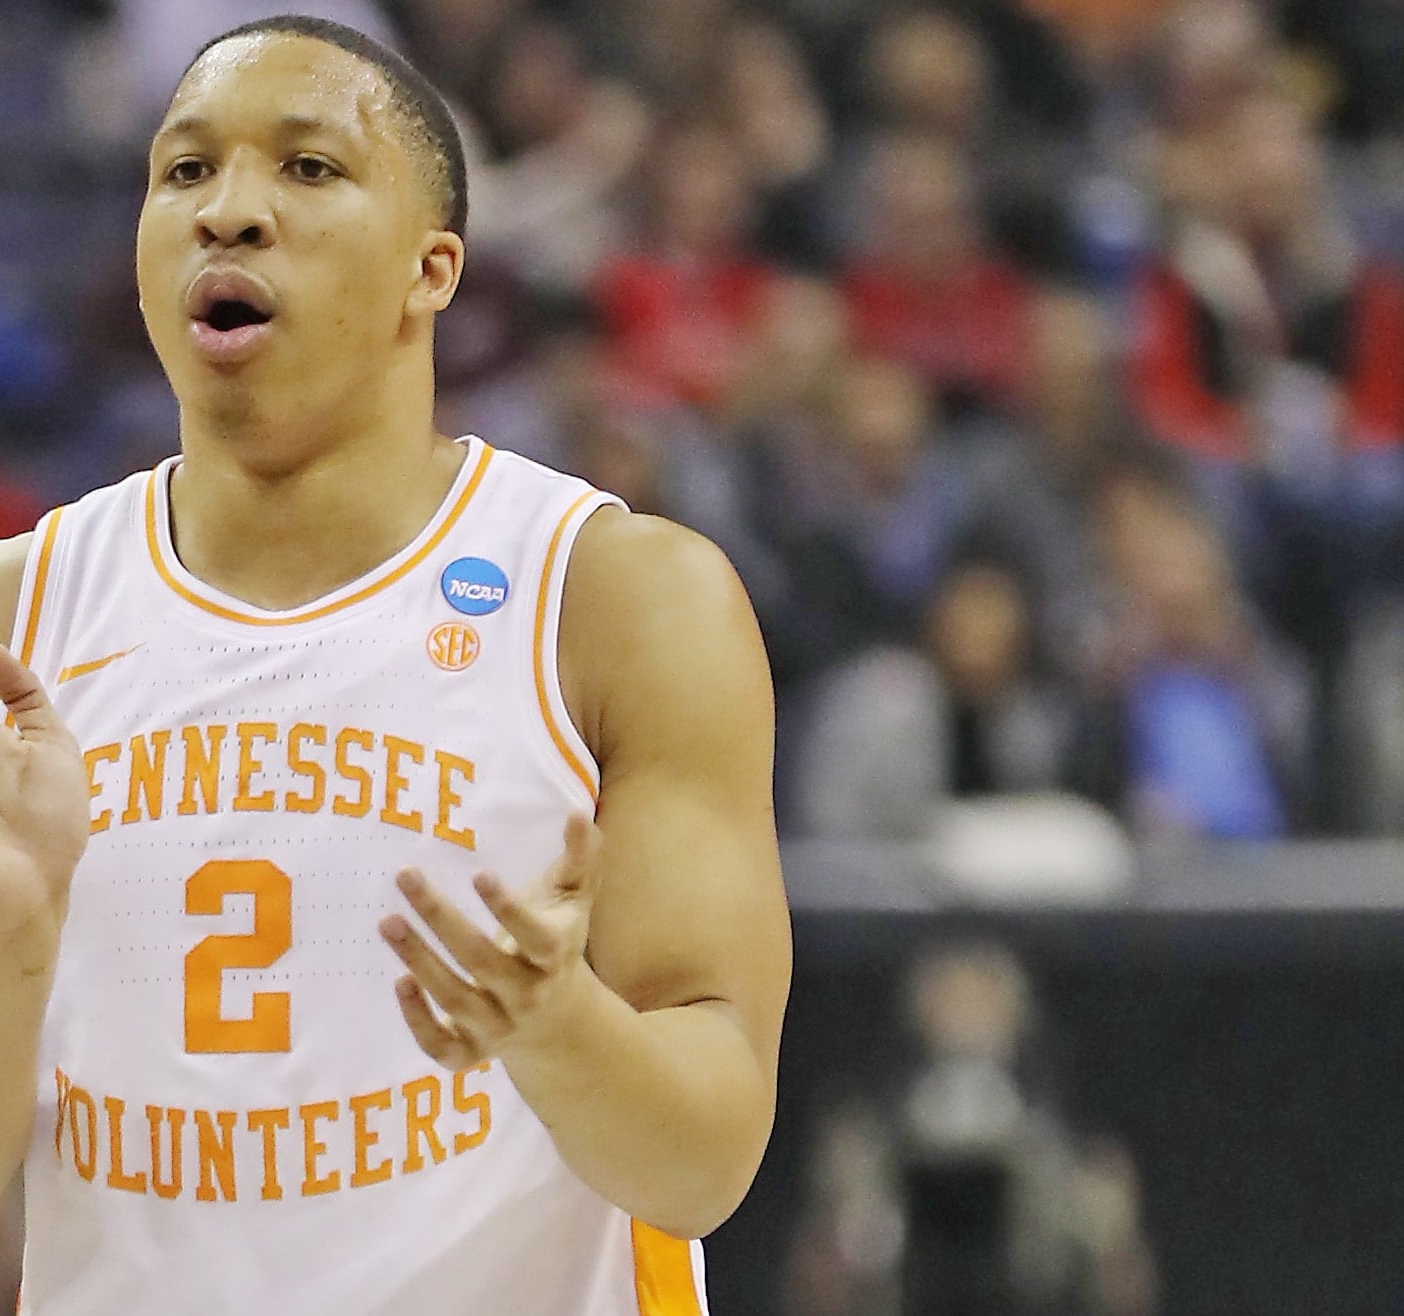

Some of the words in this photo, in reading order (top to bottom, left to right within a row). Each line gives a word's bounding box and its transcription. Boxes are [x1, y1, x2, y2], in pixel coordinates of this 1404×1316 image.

[449, 579, 505, 602] NCAA
[433, 626, 476, 666] SEC
[83, 721, 476, 851] ENNESSEE
[184, 860, 292, 1054] 2
